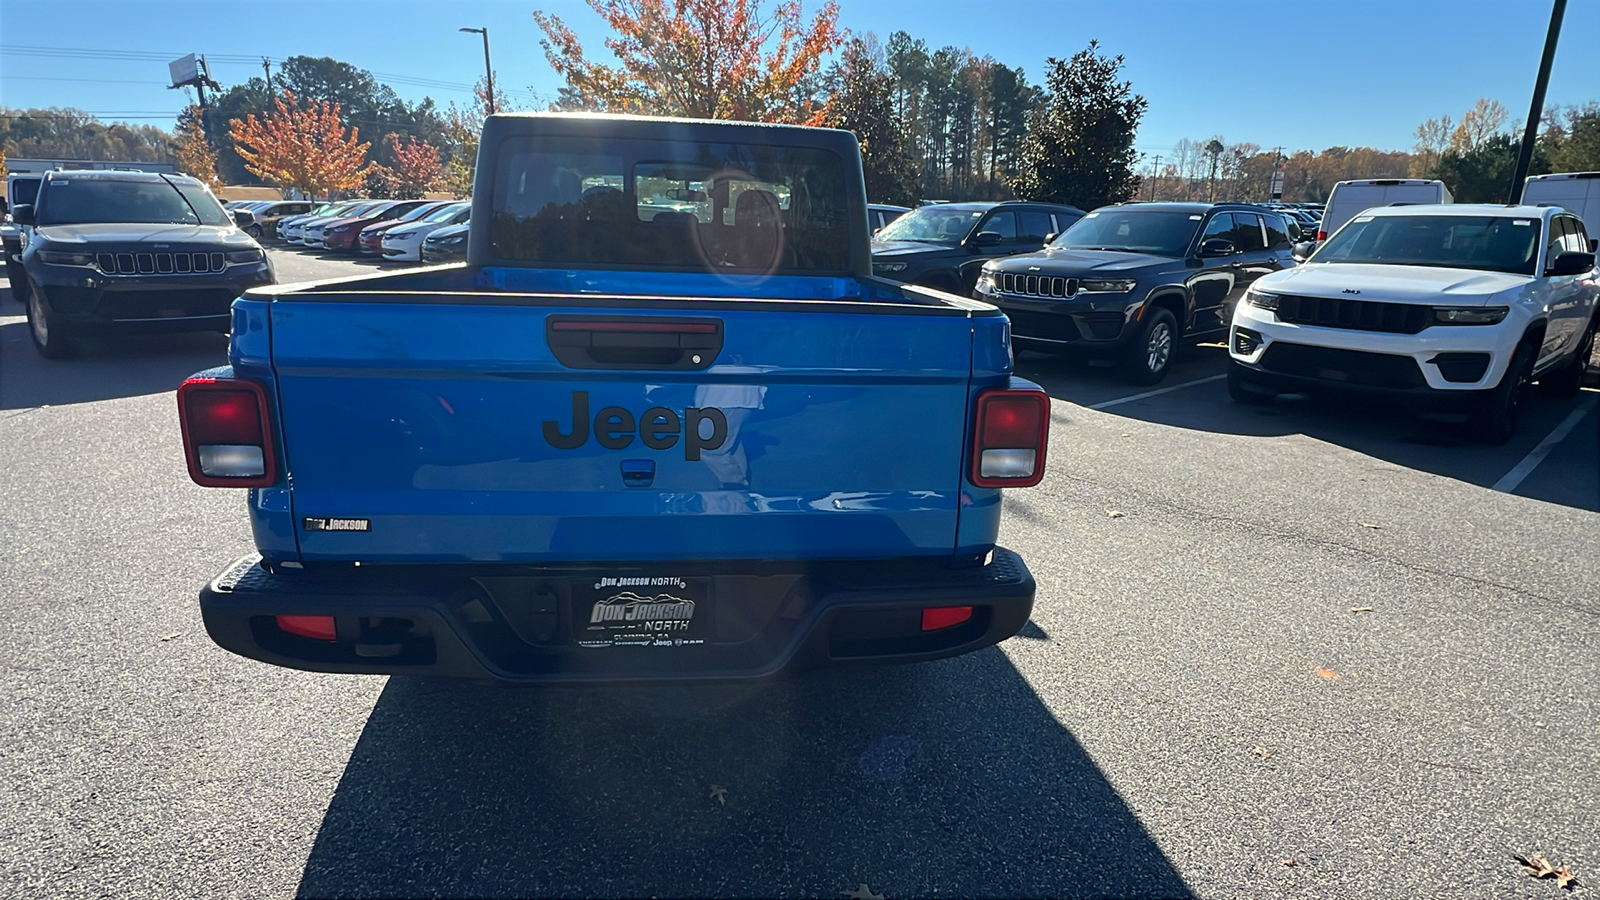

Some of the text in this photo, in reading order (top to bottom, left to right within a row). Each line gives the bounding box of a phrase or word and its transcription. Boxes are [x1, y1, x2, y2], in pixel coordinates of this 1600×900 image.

[542, 391, 728, 461] Jeep
[326, 518, 368, 531] JACKSON
[650, 577, 681, 586] NORTH
[590, 602, 695, 623] DON JACKSON
[644, 620, 690, 631] NORTH
[653, 639, 673, 647] Jeep
